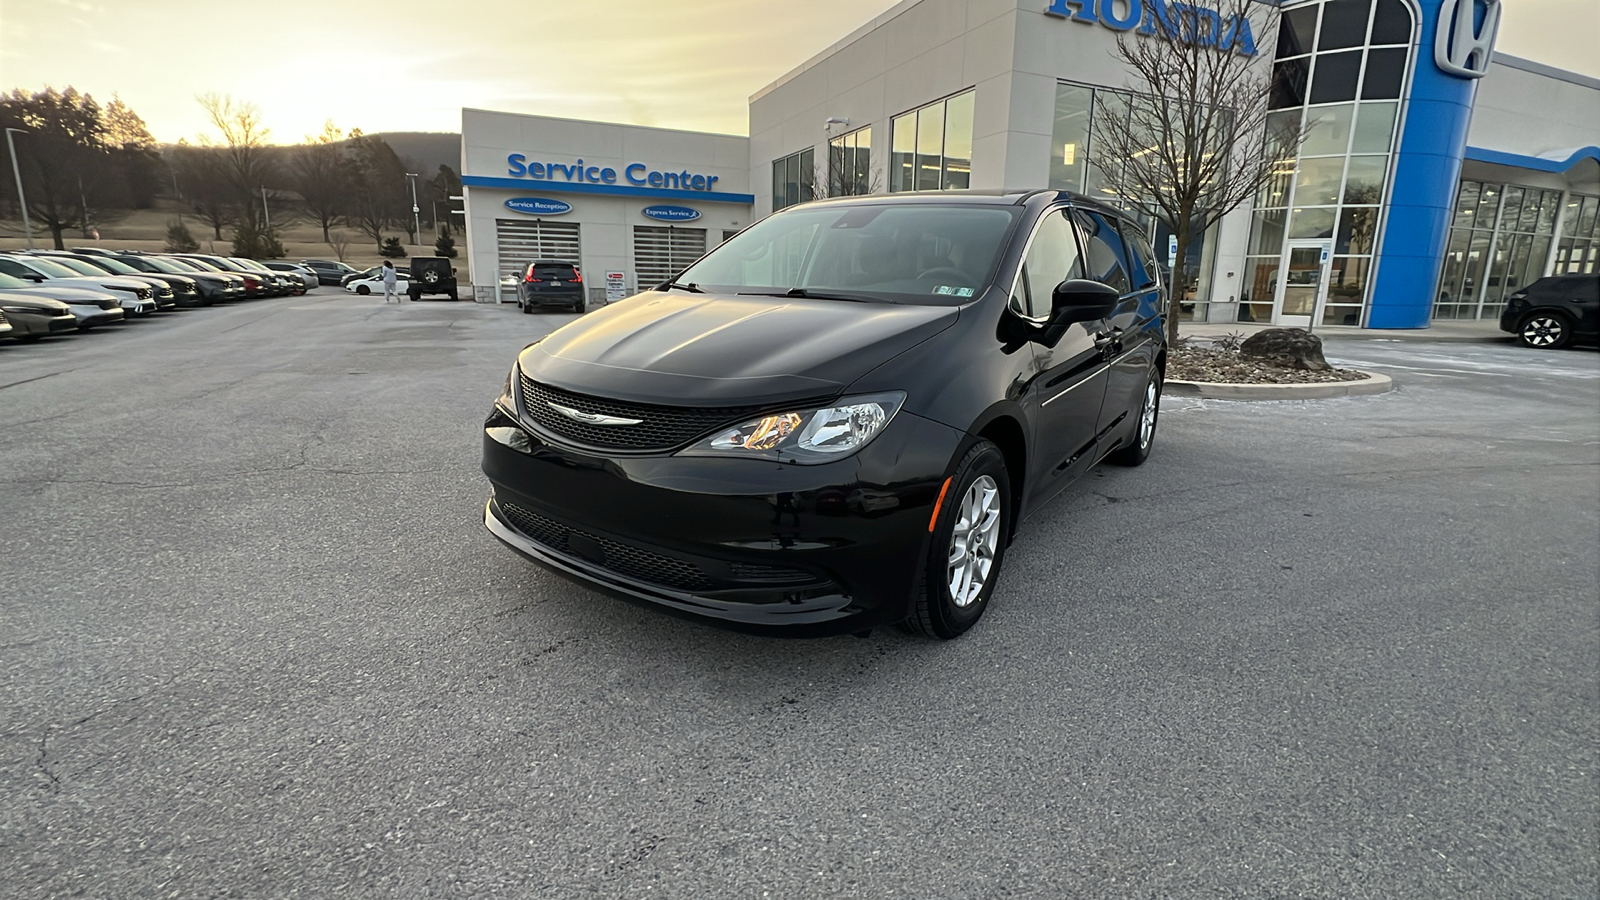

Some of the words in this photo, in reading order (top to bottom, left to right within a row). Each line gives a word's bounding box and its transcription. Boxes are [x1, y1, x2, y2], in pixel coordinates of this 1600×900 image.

[508, 153, 616, 183] Service
[625, 163, 718, 190] Center
[535, 202, 568, 210] Reception
[645, 208, 668, 216] Express
[668, 209, 690, 217] Service
